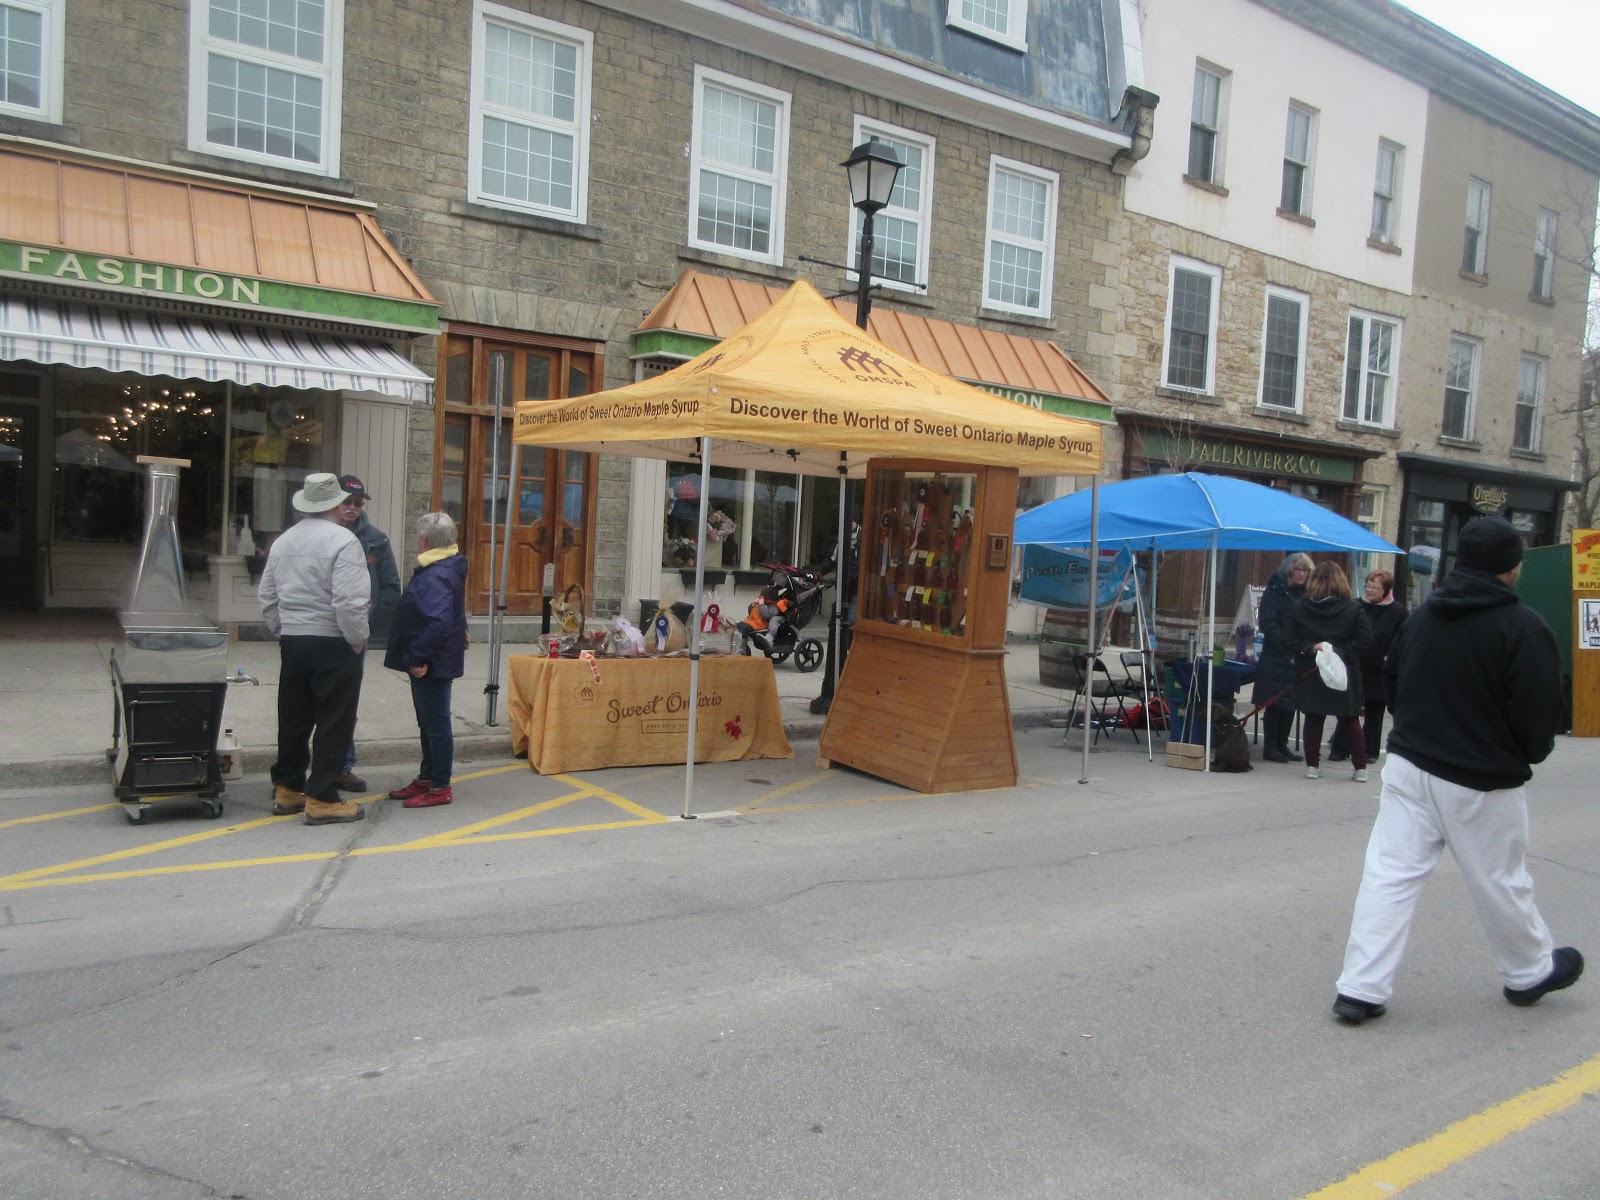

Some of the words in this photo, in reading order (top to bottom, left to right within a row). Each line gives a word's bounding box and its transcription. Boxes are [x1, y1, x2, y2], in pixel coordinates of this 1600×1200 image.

[20, 246, 260, 305] FASHION
[855, 374, 917, 389] OMSPA
[519, 412, 546, 425] Discover
[547, 410, 558, 423] the
[559, 407, 579, 422] World
[580, 405, 588, 420] of
[589, 406, 612, 420] Sweet
[612, 403, 642, 418] Ontario
[643, 401, 670, 419] Maple
[671, 399, 699, 418] Syrup
[730, 398, 808, 421] Discover
[812, 408, 838, 425] the
[843, 411, 890, 431] World
[894, 417, 910, 433] of
[913, 418, 958, 439] Sweet
[962, 424, 1013, 444] Ontario
[1017, 431, 1056, 451] Maple
[1058, 436, 1093, 456] Syrup
[1026, 565, 1063, 580] Perth
[606, 695, 664, 724] Sweet
